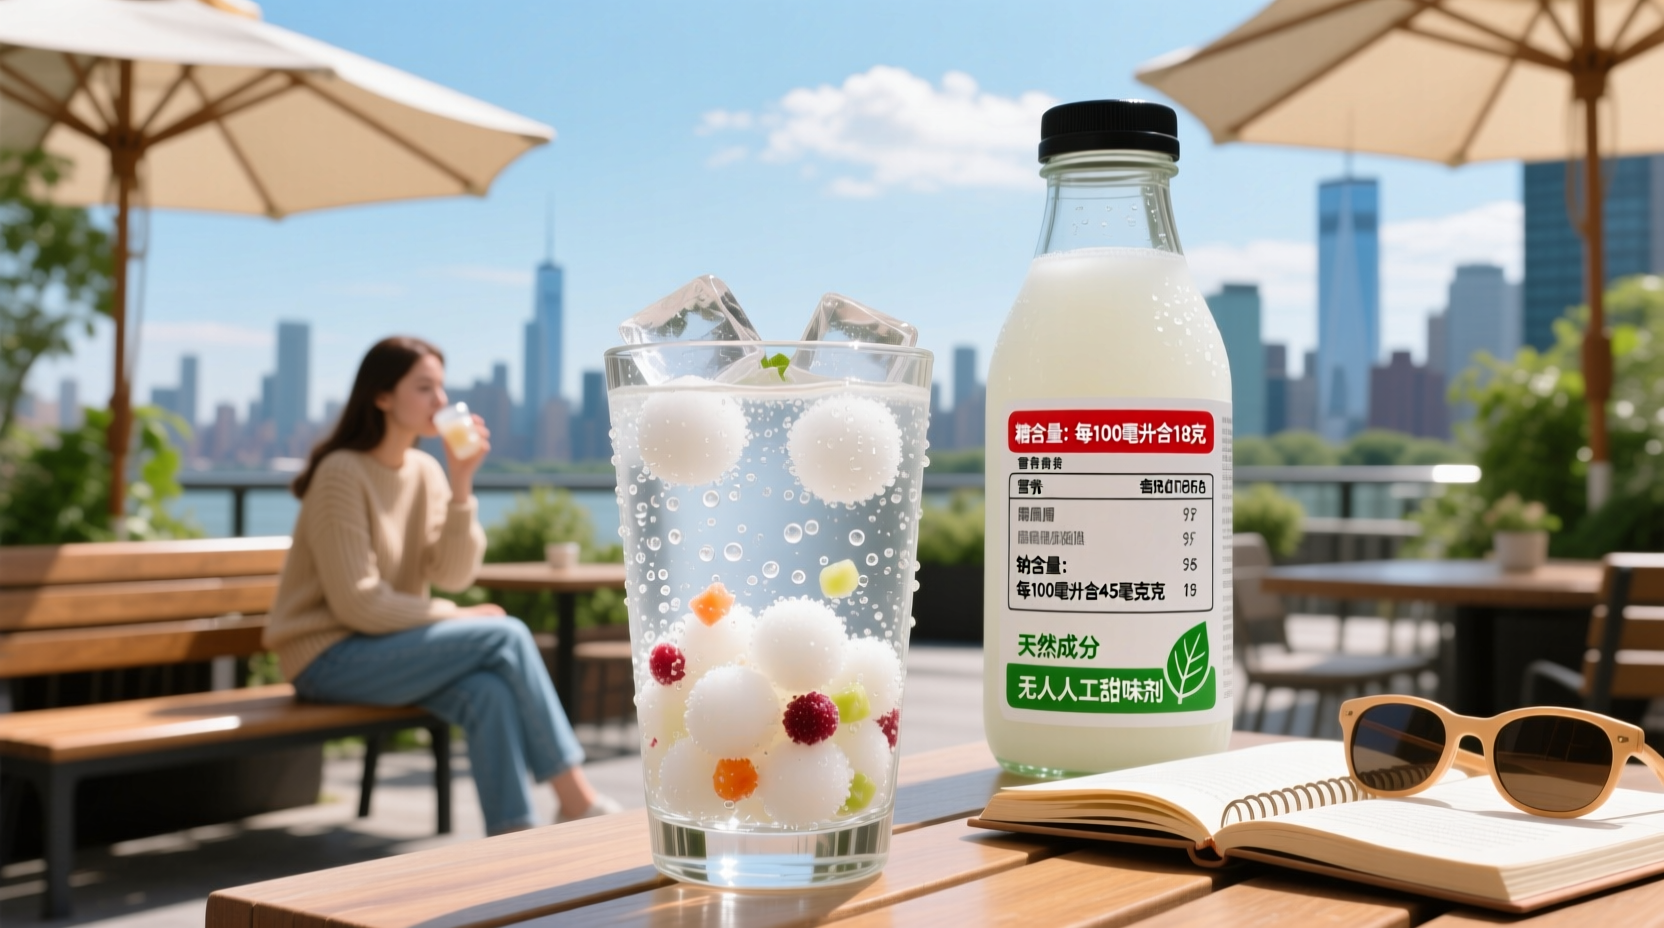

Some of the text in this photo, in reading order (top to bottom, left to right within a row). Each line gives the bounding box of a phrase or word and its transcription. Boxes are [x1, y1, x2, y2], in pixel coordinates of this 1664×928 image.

[1018, 632, 1100, 660] 天然成分
[1018, 675, 1164, 704] 无人人工甜味剂
